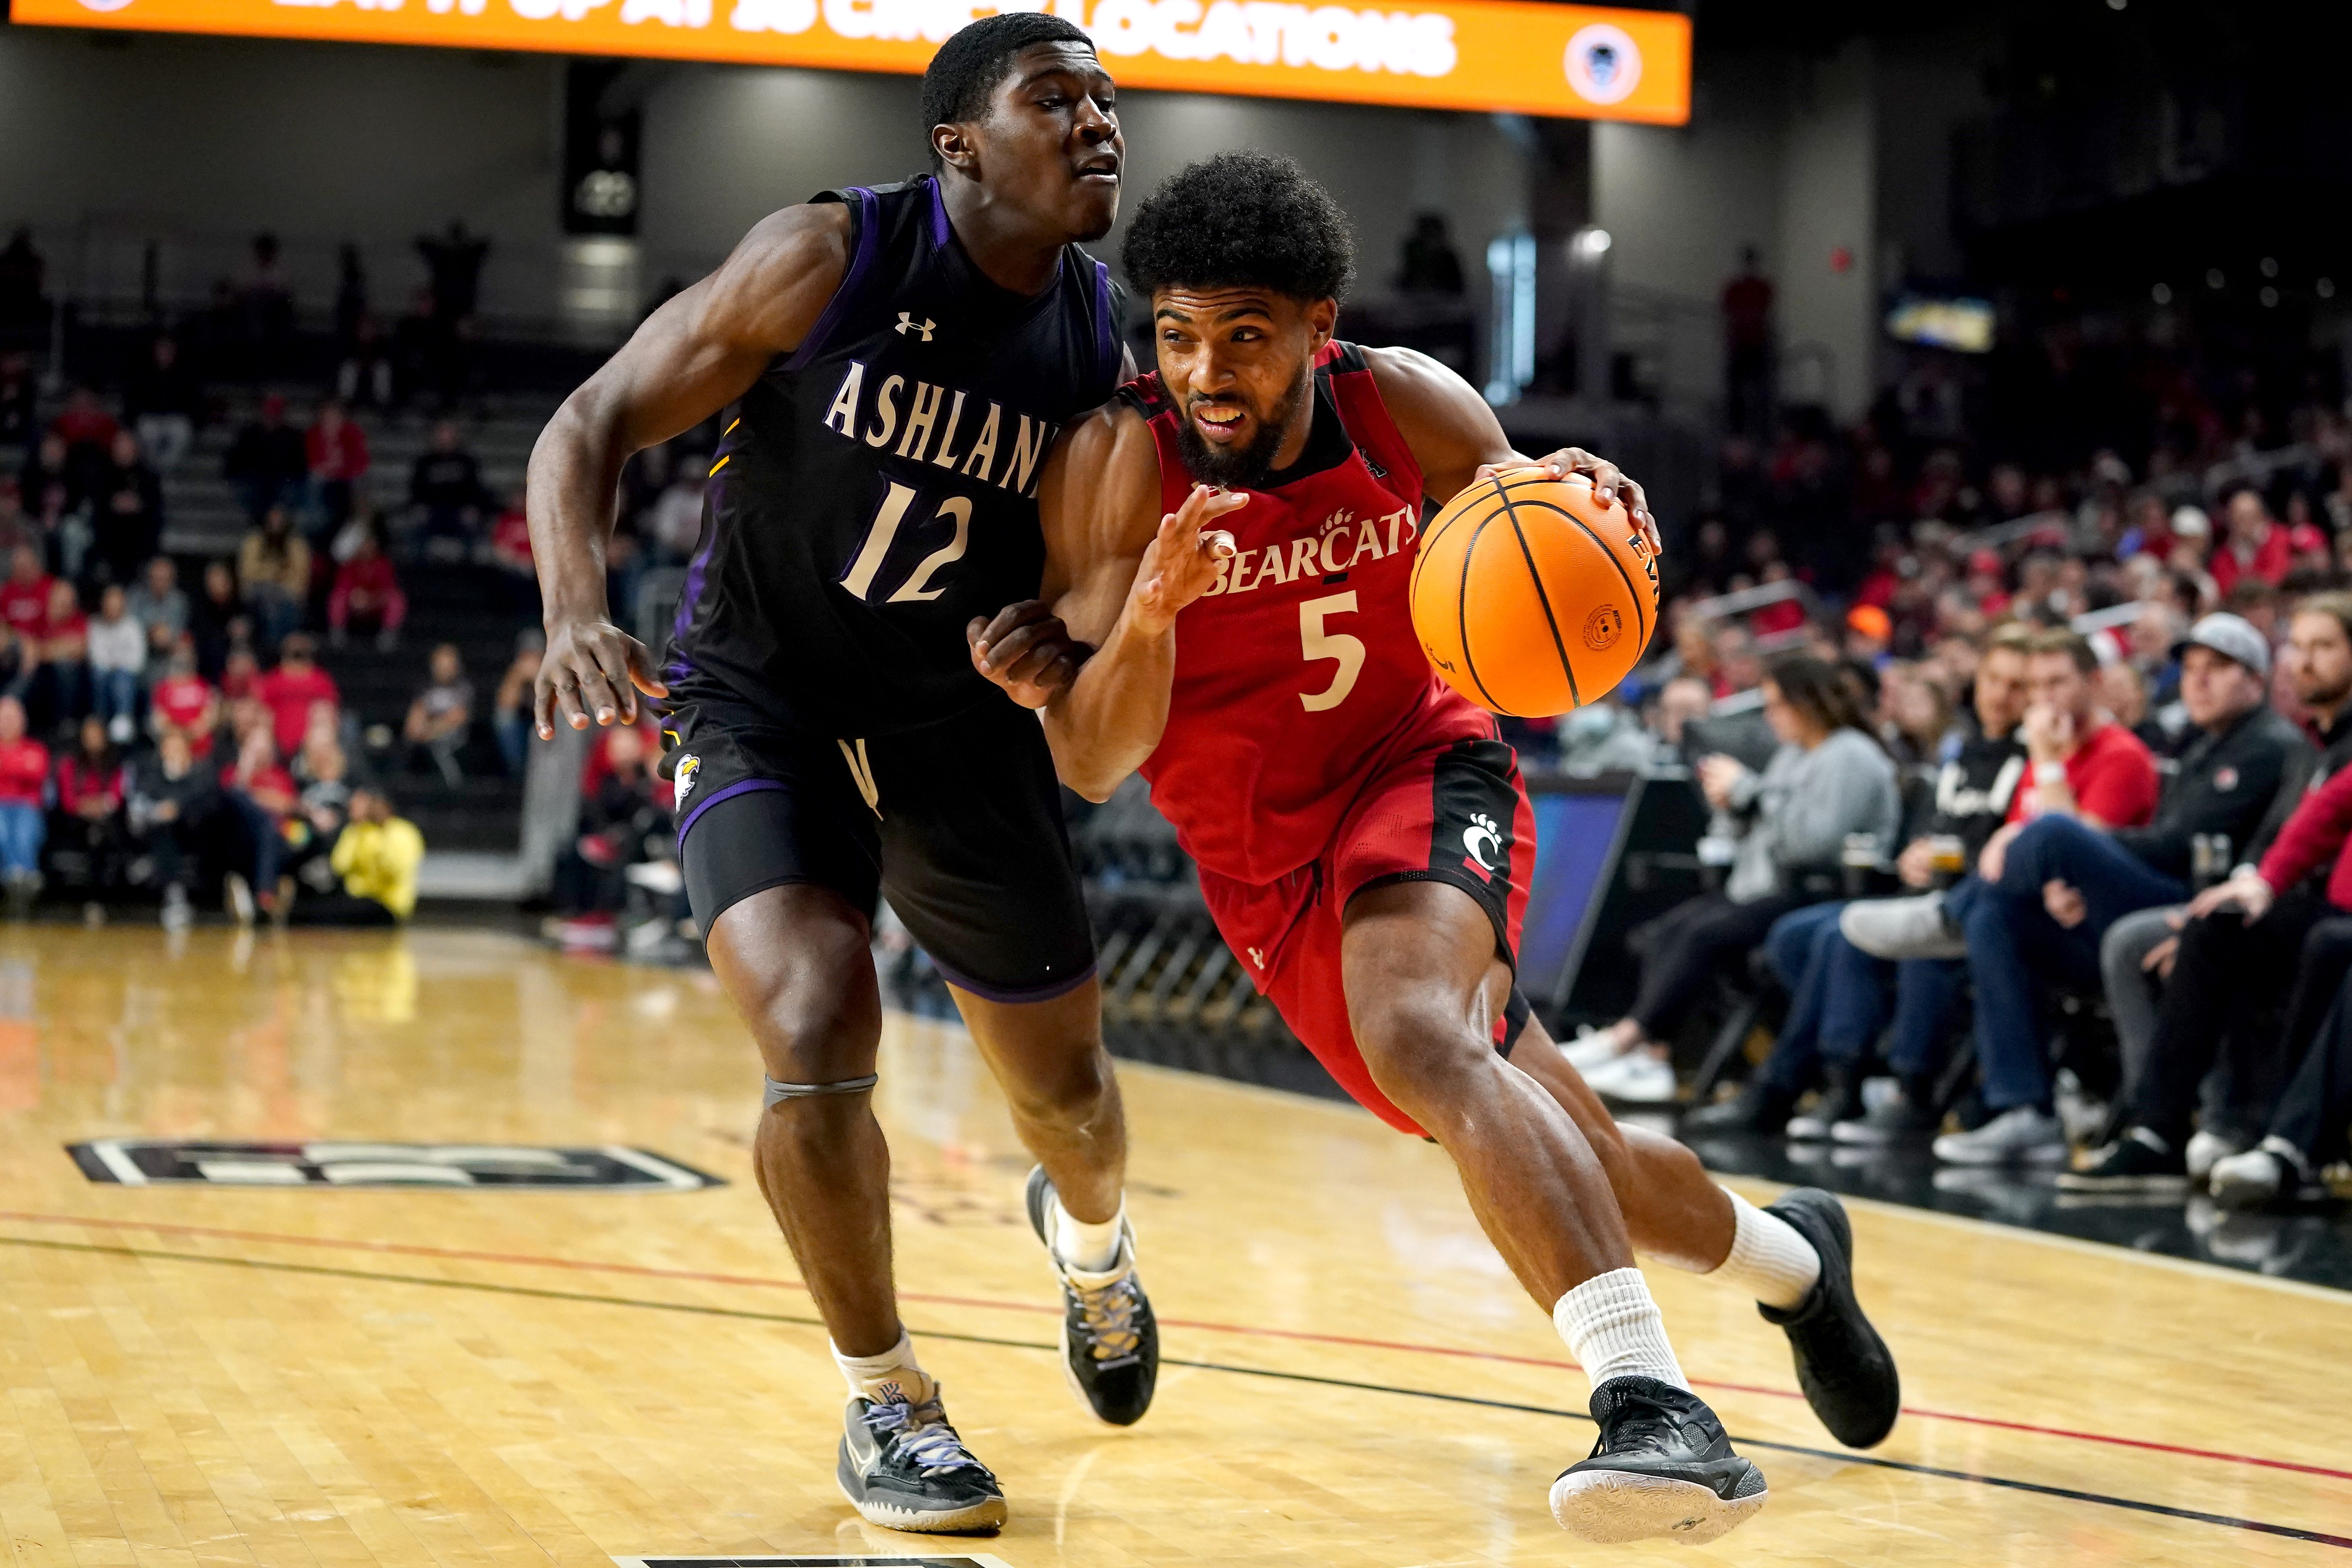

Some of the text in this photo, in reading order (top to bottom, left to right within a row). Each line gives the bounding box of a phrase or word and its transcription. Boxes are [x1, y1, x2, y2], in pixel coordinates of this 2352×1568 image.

[823, 360, 1060, 499] ASHLAN
[837, 479, 973, 604] 12
[1298, 590, 1366, 712] 5
